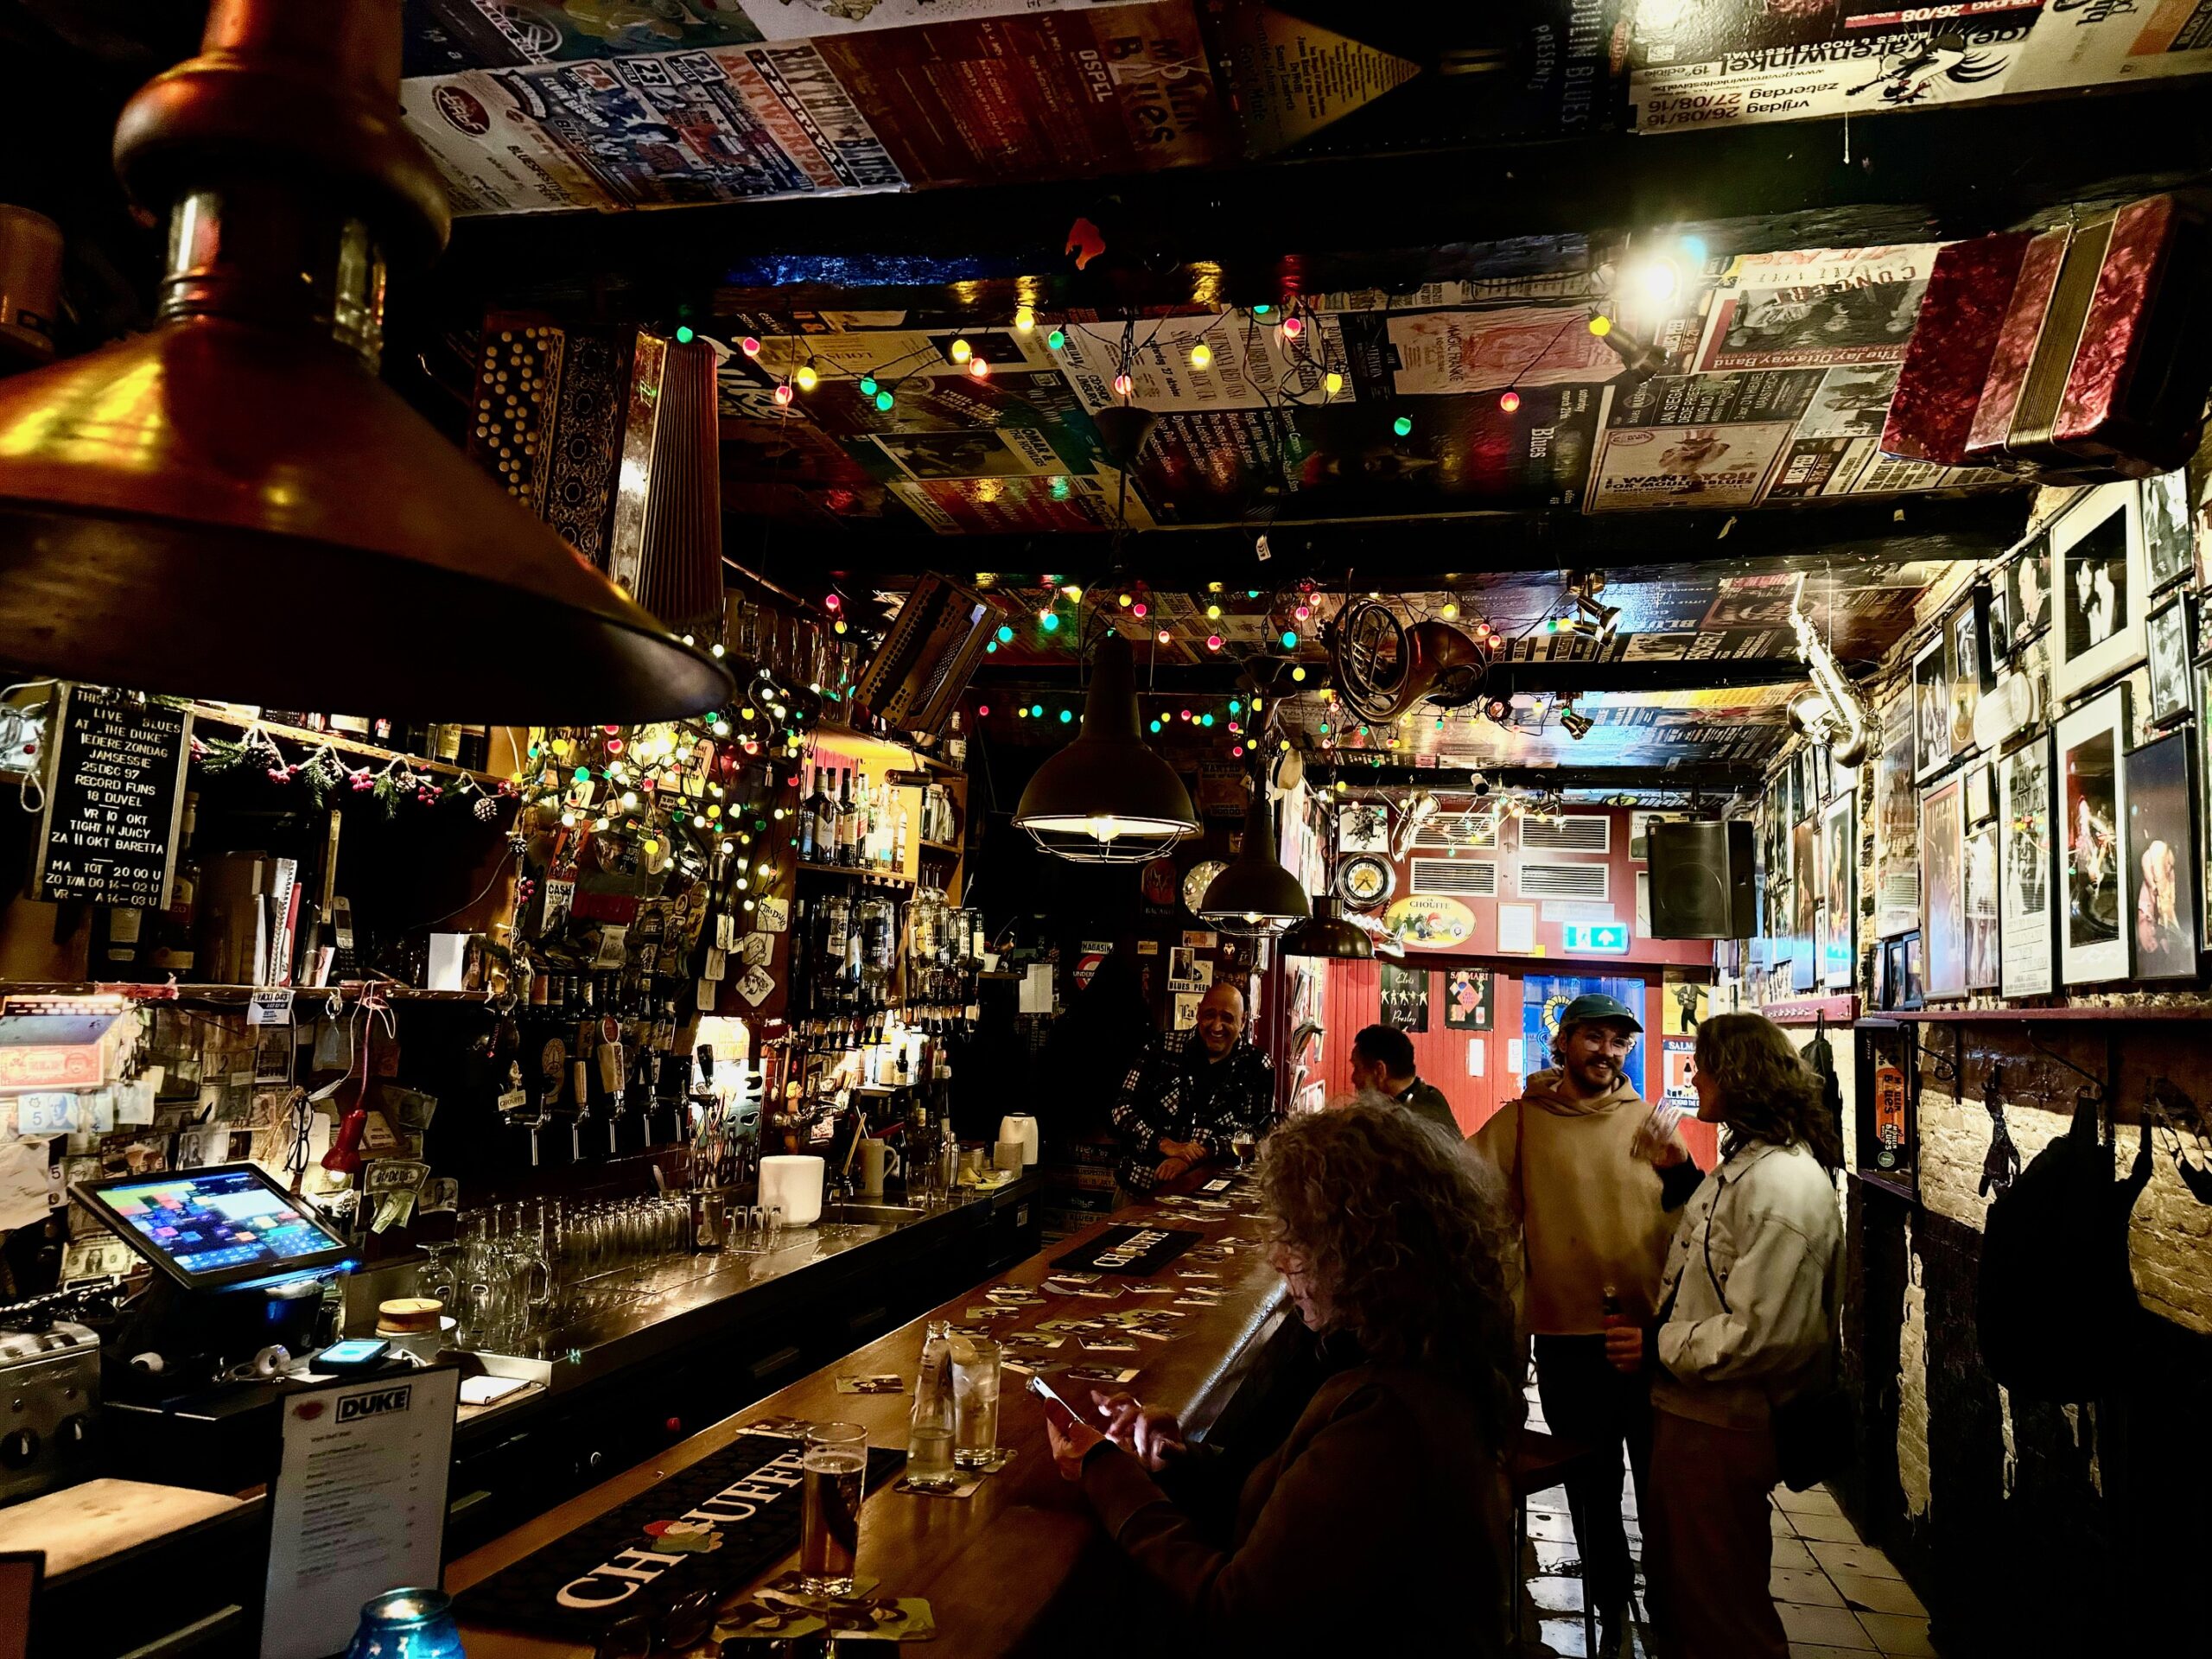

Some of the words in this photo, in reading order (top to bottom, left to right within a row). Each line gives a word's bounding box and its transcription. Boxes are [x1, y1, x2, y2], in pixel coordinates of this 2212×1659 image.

[1901, 5, 1961, 22] 26/08
[1724, 46, 1799, 60] FESTIVAL
[1801, 40, 1851, 52] ROOTS
[632, 64, 666, 83] 23
[690, 55, 719, 79] 22
[1078, 49, 1114, 103] OSPEL
[1749, 82, 1840, 100] zaterdag
[1648, 92, 1743, 111] 27/08/16
[1746, 99, 1809, 115] vrijdag
[717, 54, 844, 187] ANTWERPEN
[757, 61, 846, 177] FESTIVAL
[1648, 106, 1738, 125] 26/08/16
[1771, 265, 1916, 306] CONCERT
[1713, 357, 1755, 369] Band
[1836, 352, 1861, 362] Jay
[1867, 351, 1899, 360] The
[1089, 375, 1111, 401] CD-SHOP
[1683, 383, 1701, 406] PRIEST
[1561, 391, 1571, 406] march
[1574, 389, 1589, 412] saturday
[1665, 384, 1686, 411] SIEGAL
[1700, 396, 1714, 408] MO
[1192, 414, 1202, 424] Tim
[1210, 413, 1222, 424] The
[1660, 412, 1675, 425] IAN
[1677, 407, 1692, 423] DEDE
[1694, 409, 1707, 423] KING
[1023, 429, 1049, 455] OMAR
[1529, 428, 1554, 459] Blues
[1624, 474, 1690, 486] WANT
[1700, 472, 1758, 482] YOU
[77, 690, 104, 705] THIS
[75, 719, 89, 729] AT
[94, 709, 123, 722] LIVE
[143, 718, 181, 734] BLUES
[81, 733, 122, 750] IEDERE
[124, 741, 168, 758] ZONDAG
[89, 749, 151, 768] JAMSESSIE
[124, 768, 140, 779] 97
[75, 775, 121, 790] RECORD
[125, 782, 156, 795] FUNS
[87, 790, 99, 801] 18
[105, 792, 143, 807] DUVEL
[84, 808, 99, 819] VR
[126, 814, 148, 825] OKT
[70, 819, 101, 833] TIGHT
[106, 824, 115, 834] N
[118, 826, 150, 839] JUICY
[52, 832, 67, 843] ZA
[86, 836, 110, 847] OKT
[116, 839, 163, 855] BARETTA
[52, 860, 72, 872] MA
[84, 863, 104, 874] TOT
[153, 870, 162, 880] U
[46, 873, 62, 884] ZO
[67, 875, 86, 887] T/M
[88, 878, 104, 888] DO
[151, 882, 159, 893] U
[548, 885, 570, 894] CASH
[53, 888, 69, 899] VR
[149, 896, 156, 906] U
[1409, 900, 1451, 910] CHOUFFE
[1169, 982, 1190, 990] BLUES
[1395, 972, 1414, 984] Elvis
[256, 993, 273, 1001] TAXI
[1392, 1010, 1416, 1025] Presley
[1669, 1041, 1696, 1051] SALM
[51, 1166, 60, 1180] 5
[1093, 1230, 1169, 1267] CHUFFE
[341, 1391, 405, 1418] DUKE
[556, 1450, 804, 1607] CHUFFE
